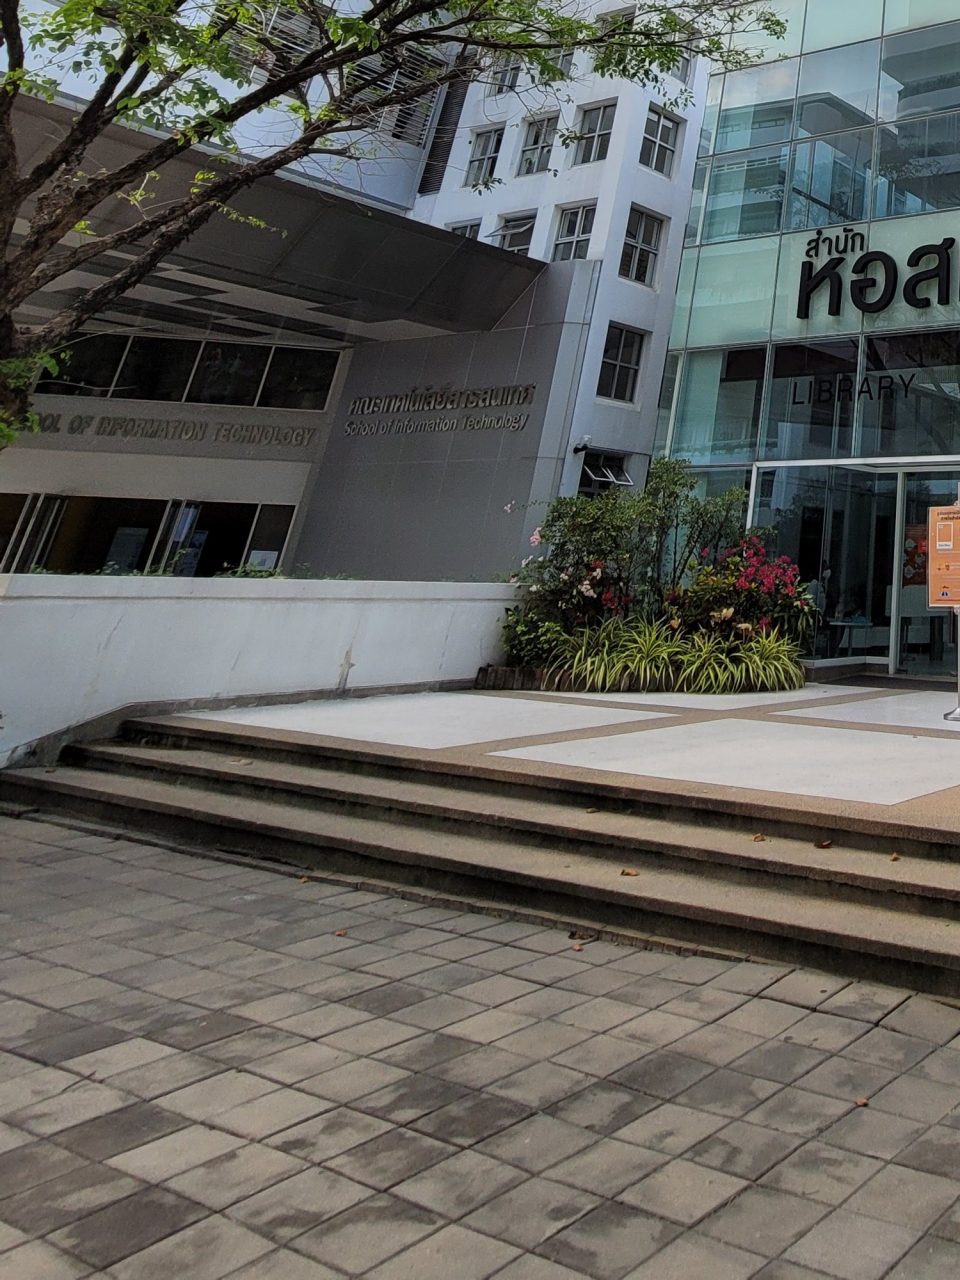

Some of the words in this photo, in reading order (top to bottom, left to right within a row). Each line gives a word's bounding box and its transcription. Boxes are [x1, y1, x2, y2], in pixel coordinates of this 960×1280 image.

[805, 227, 865, 258] สำนัก
[791, 373, 917, 405] LIBRARY
[67, 414, 95, 435] OF
[95, 416, 208, 441] INFORMATION
[214, 422, 317, 447] TECHNOLOGY
[344, 420, 378, 436] School
[380, 420, 394, 434] of
[393, 415, 458, 434] Information
[462, 412, 530, 432] Technology
